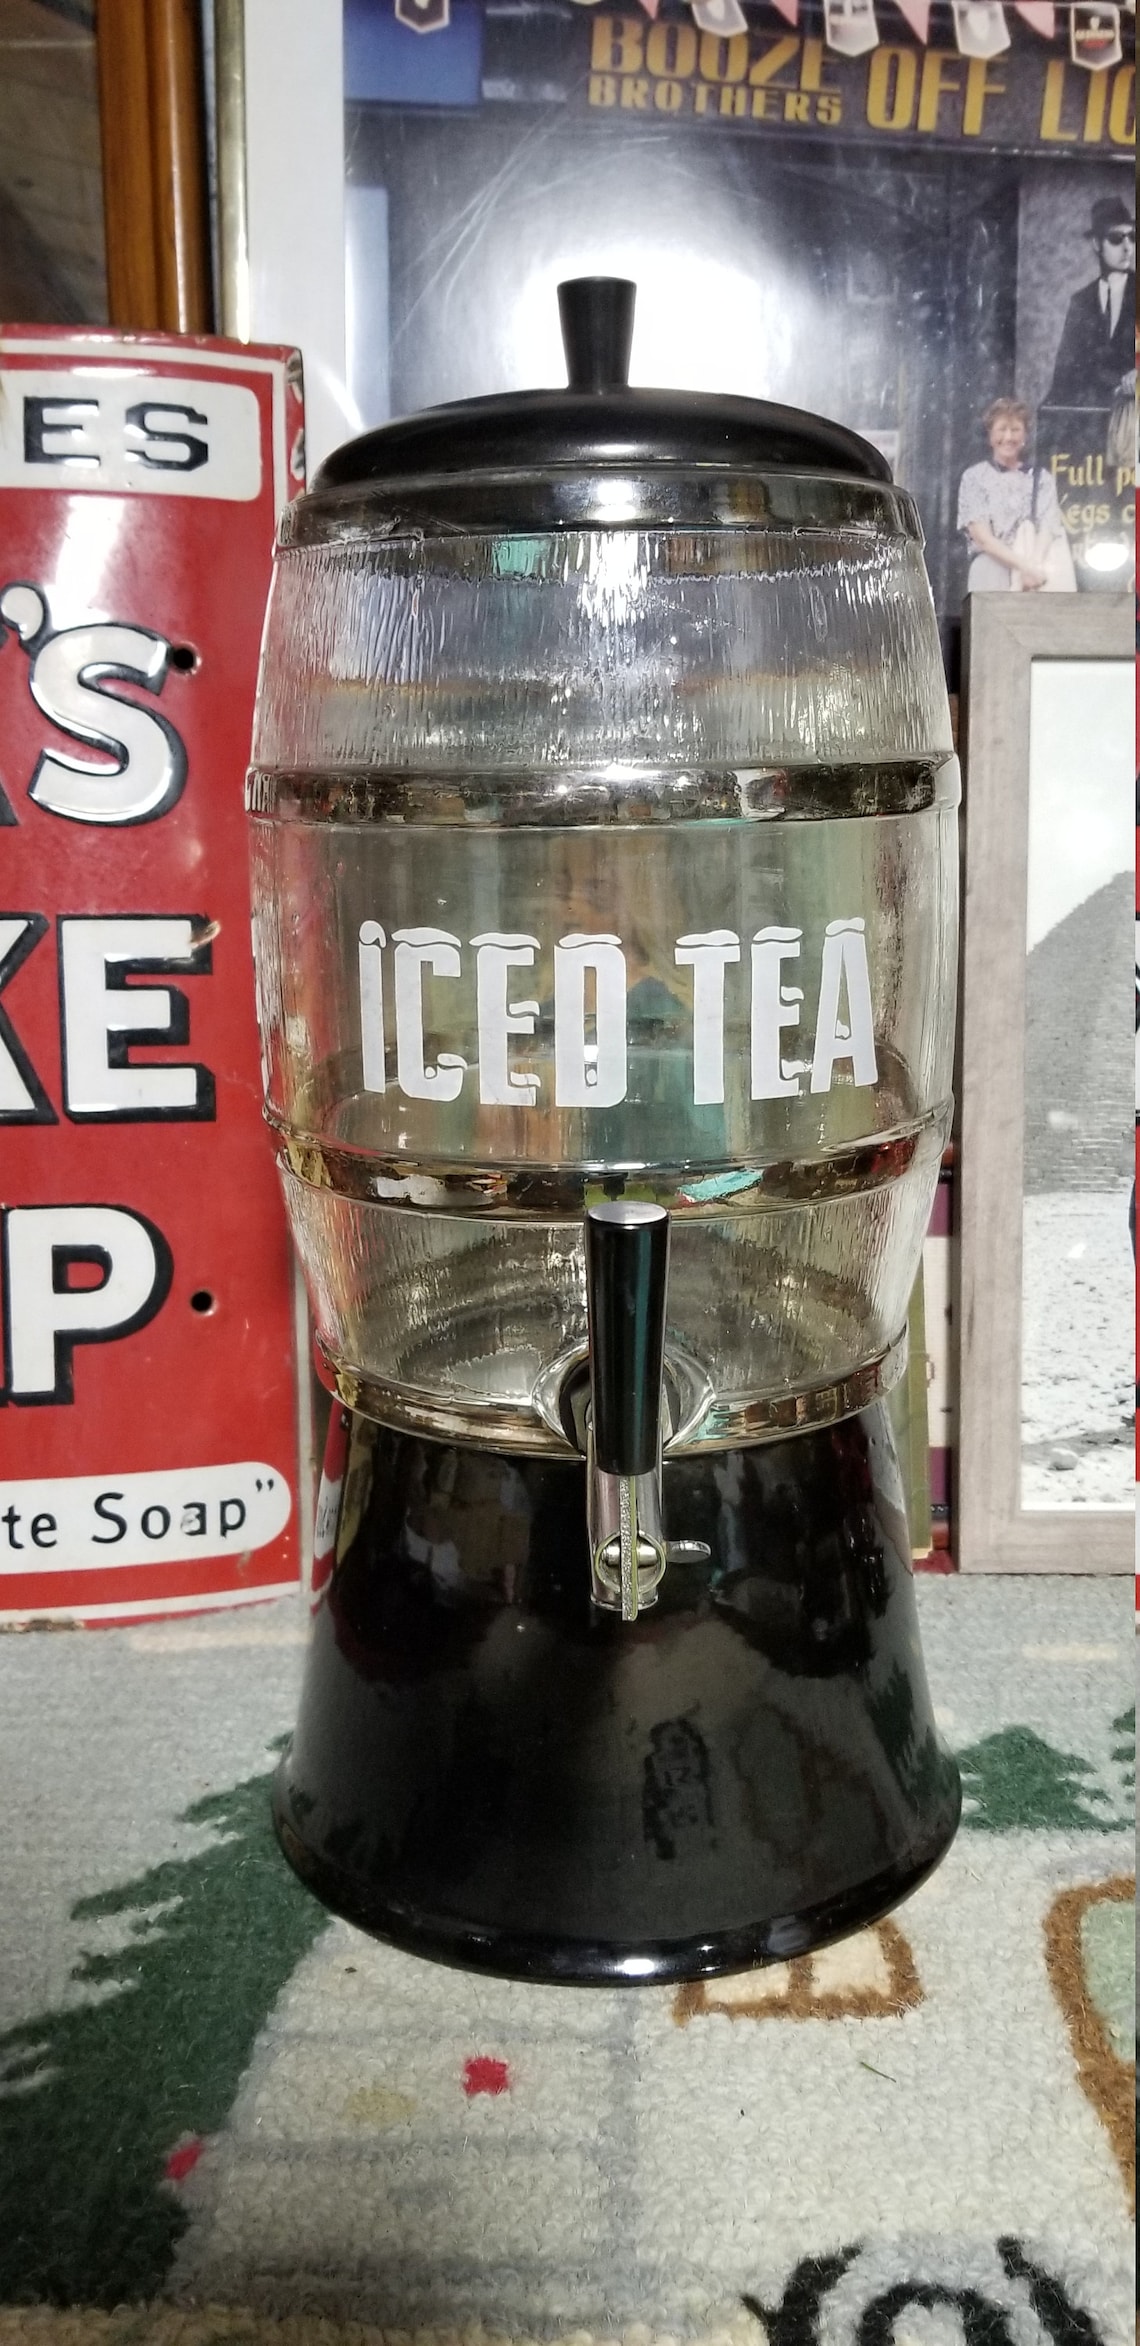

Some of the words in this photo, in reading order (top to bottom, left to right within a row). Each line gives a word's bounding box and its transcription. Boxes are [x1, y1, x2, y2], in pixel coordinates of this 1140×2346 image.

[590, 17, 843, 95] BOOZE
[867, 47, 1006, 136] OFF
[588, 76, 843, 125] BROTHERS
[24, 396, 208, 471] ES
[1050, 453, 1105, 486] Full
[0, 581, 188, 828] 'S
[358, 919, 629, 1108] ICED
[674, 918, 878, 1105] TEA
[1, 1504, 58, 1550] te
